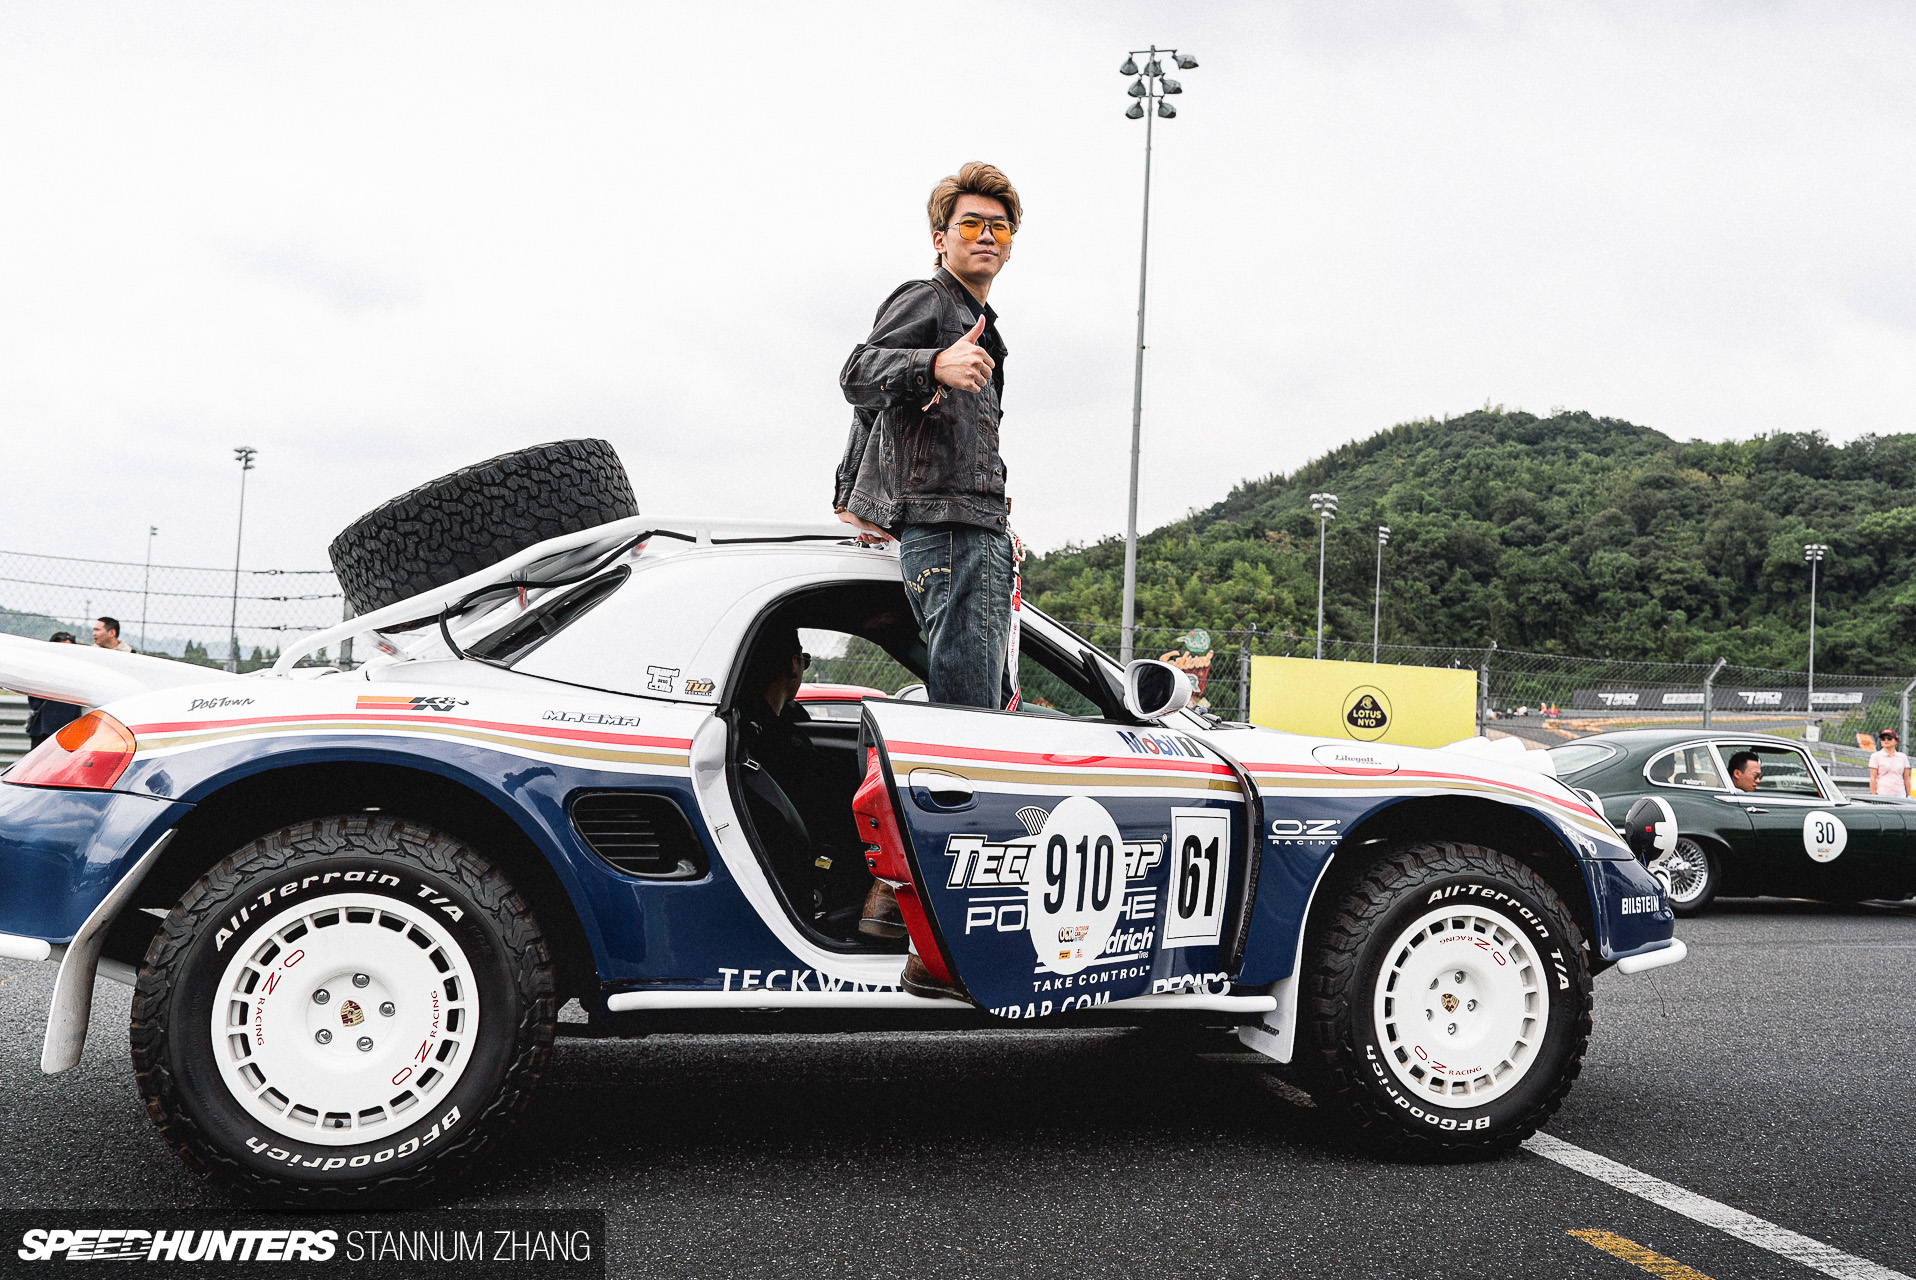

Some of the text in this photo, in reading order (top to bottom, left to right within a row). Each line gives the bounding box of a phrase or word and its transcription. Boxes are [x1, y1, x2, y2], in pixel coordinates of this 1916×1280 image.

[542, 710, 641, 727] MAGMA
[1353, 709, 1382, 719] LOTUS
[1357, 719, 1376, 727] NYO
[1116, 731, 1184, 756] Mobil
[1815, 821, 1835, 844] 30
[1043, 833, 1114, 915] 910
[1177, 834, 1219, 920] 61
[215, 870, 400, 952] All-Terrain
[417, 884, 465, 923] T/A
[1621, 895, 1660, 915] BILSTEIN
[1428, 884, 1570, 991] All-Terrain T/A
[1439, 936, 1474, 945] RACING
[1033, 976, 1073, 993] TAKE
[255, 997, 266, 1046] RACING
[429, 990, 438, 1038] RACING
[1448, 1065, 1483, 1077] RACING
[1365, 1044, 1491, 1132] BFGoodrich
[245, 1105, 462, 1172] BFGoodrich
